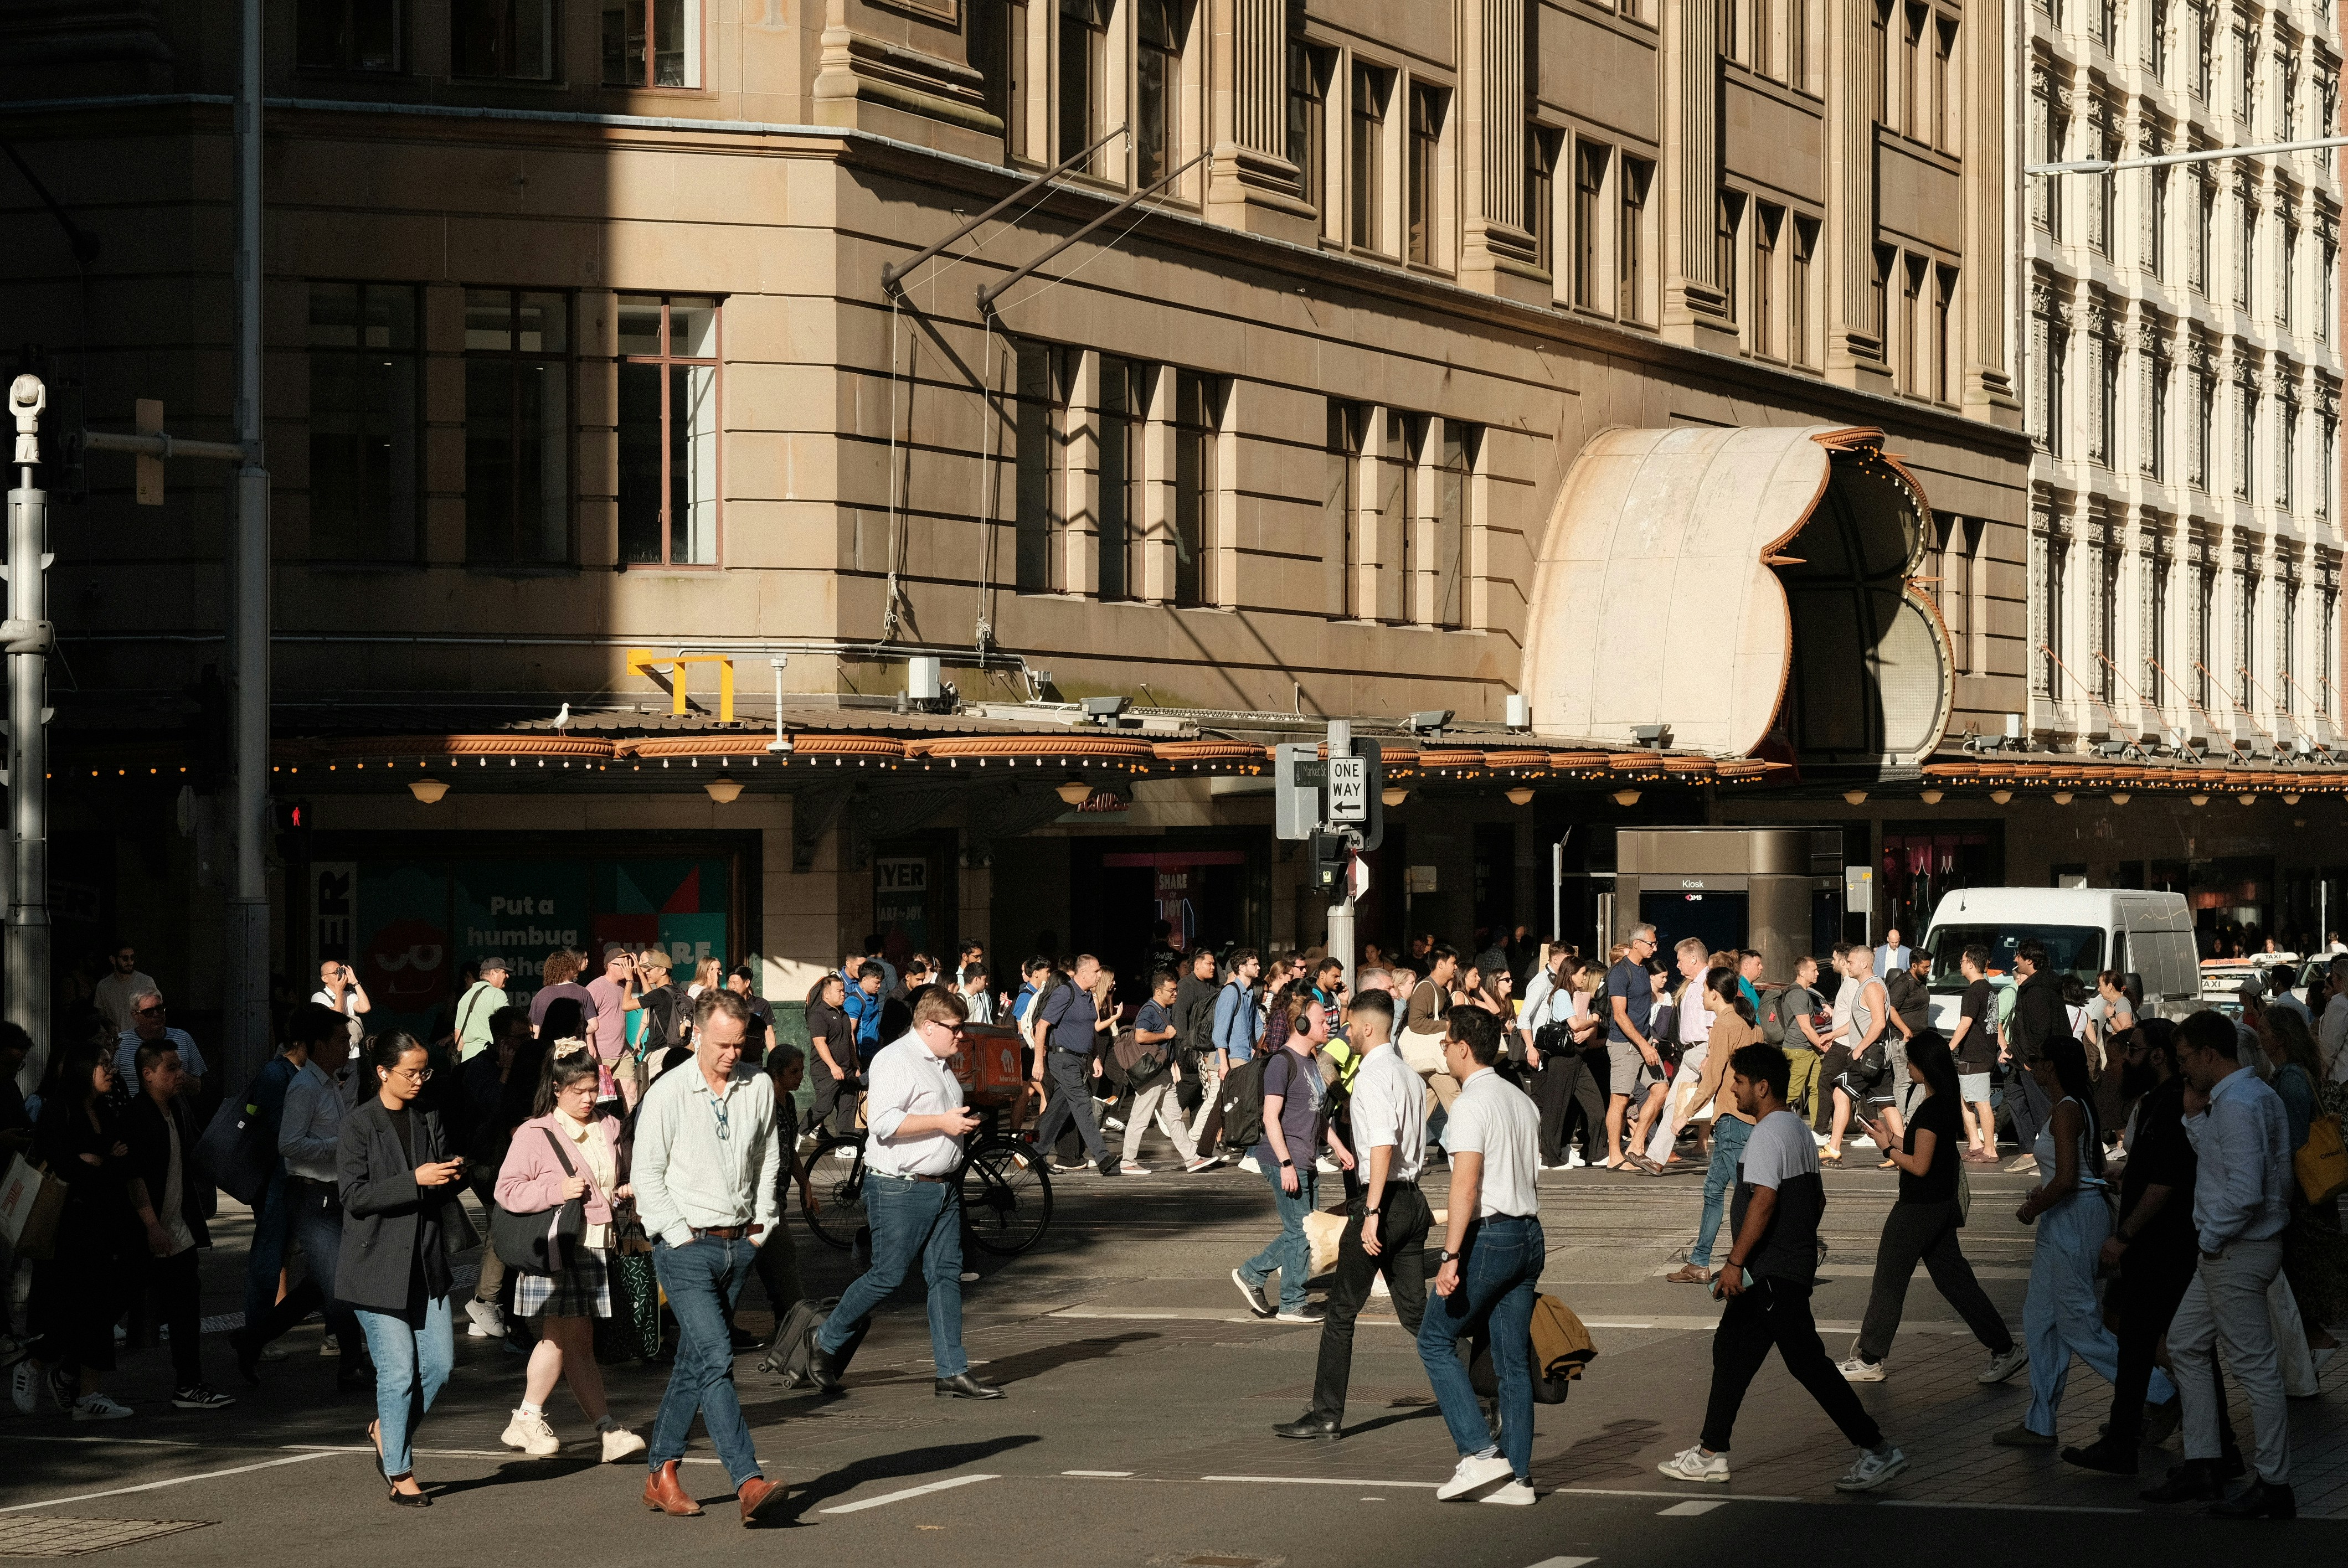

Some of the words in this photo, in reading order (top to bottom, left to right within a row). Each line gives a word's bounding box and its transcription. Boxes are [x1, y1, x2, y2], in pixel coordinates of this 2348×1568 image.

[1303, 764, 1320, 777] Market
[1321, 764, 1326, 777] St
[1335, 764, 1360, 777] ONE
[1333, 783, 1361, 796] WAY
[1158, 873, 1188, 890] SHARE
[1682, 880, 1704, 888] Kiosk
[491, 896, 534, 916] Put
[538, 899, 554, 915] a
[906, 905, 923, 921] JOY
[1164, 900, 1182, 917] JOY
[467, 925, 578, 950] humbug
